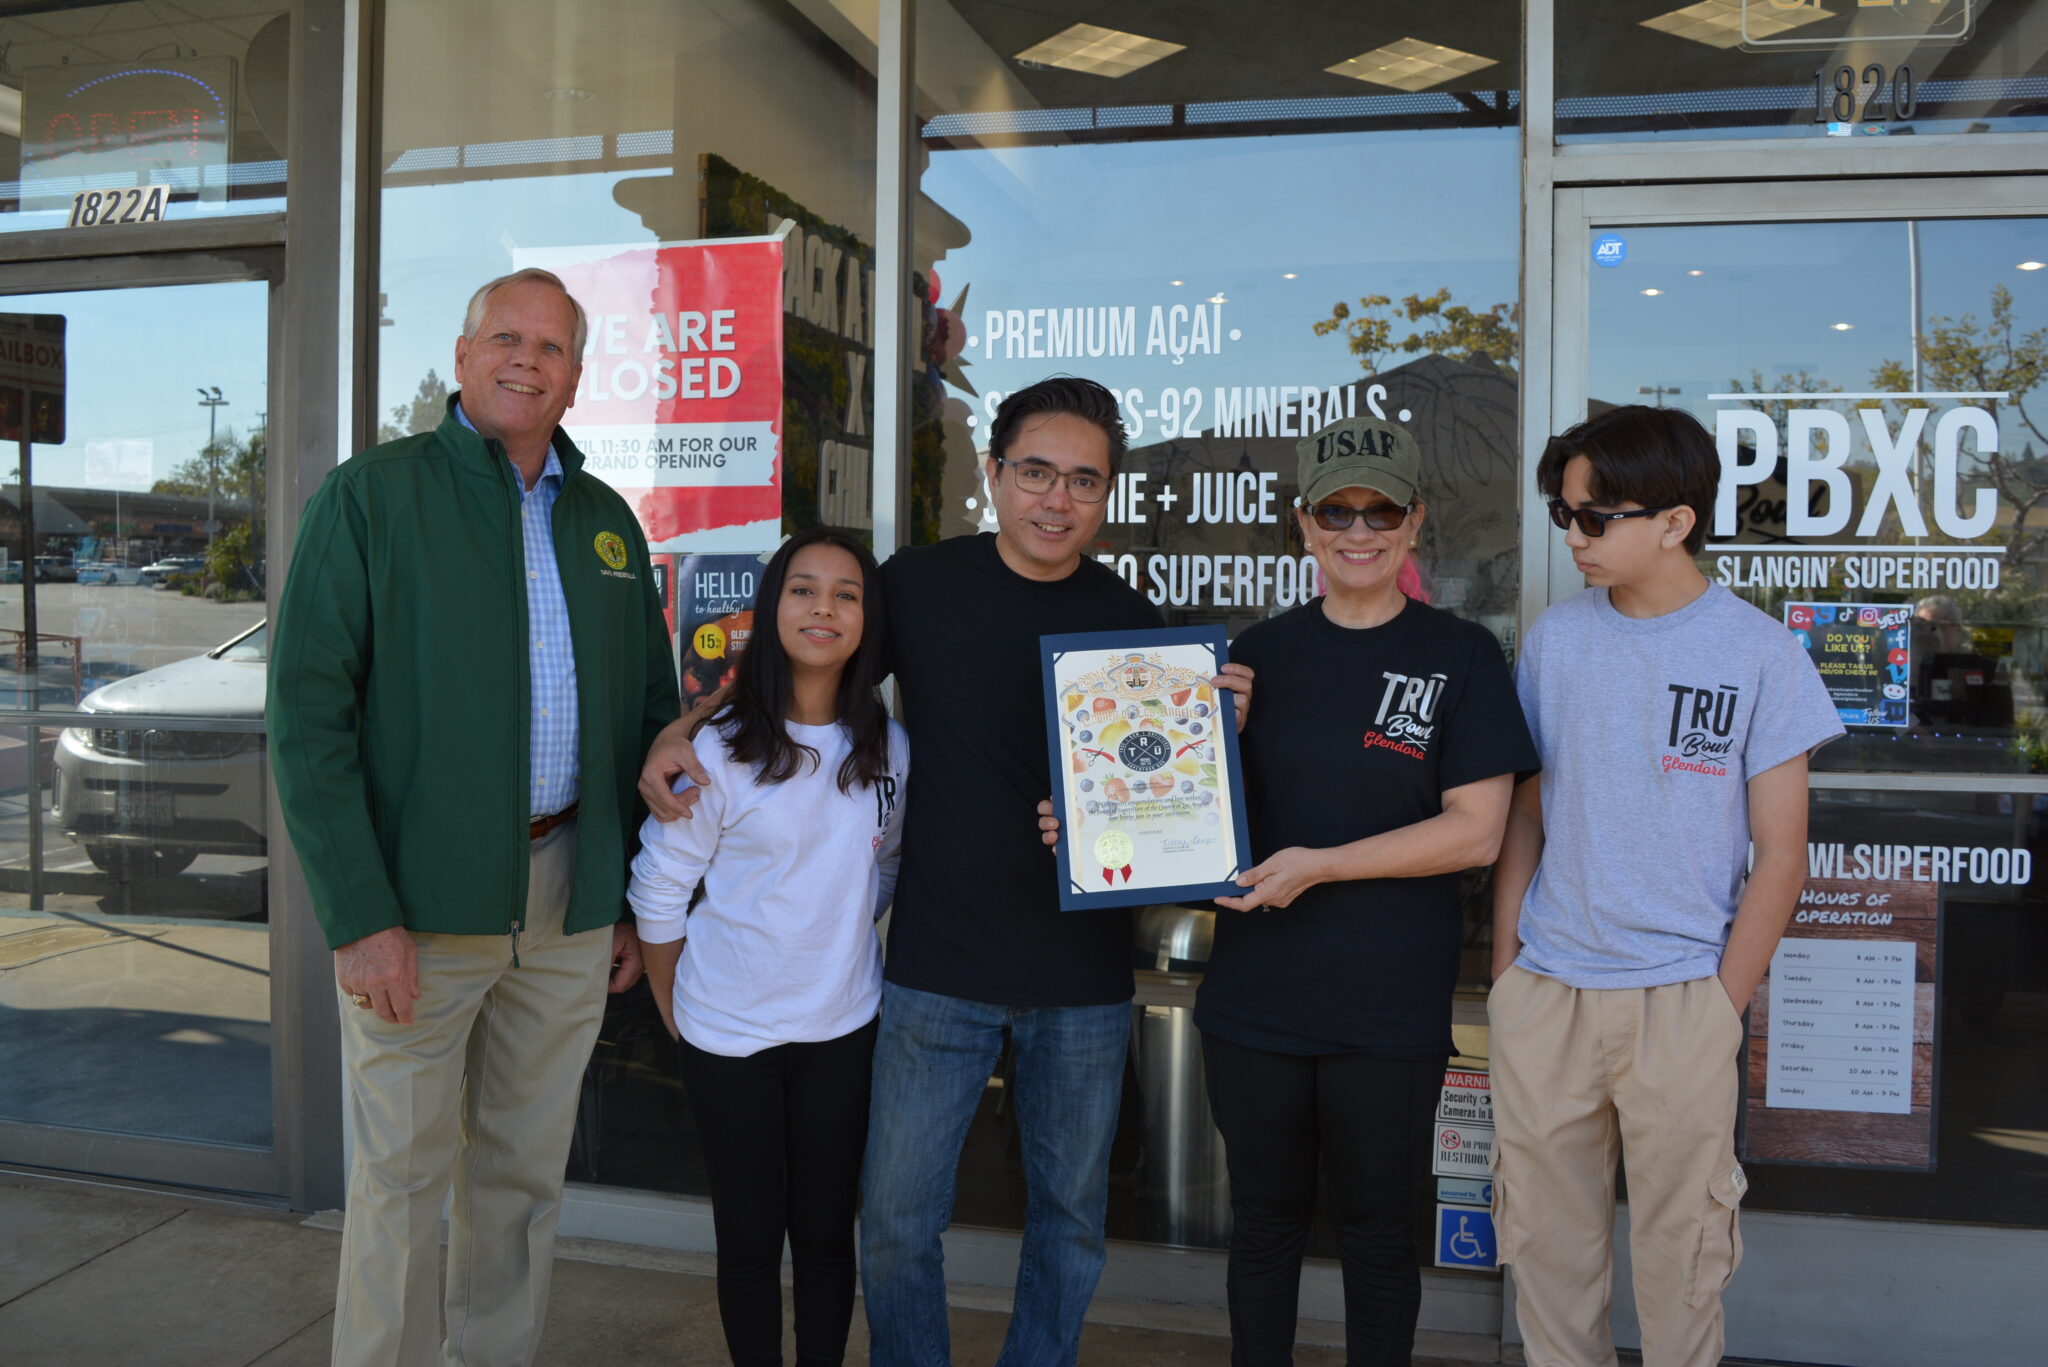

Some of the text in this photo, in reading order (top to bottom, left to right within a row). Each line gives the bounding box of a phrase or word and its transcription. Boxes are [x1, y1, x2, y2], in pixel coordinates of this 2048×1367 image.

[1813, 63, 1916, 124] 1820
[71, 187, 162, 227] 1822A
[1596, 242, 1623, 256] ADT
[642, 309, 736, 354] ARE
[985, 305, 1136, 360] PREMIUM
[574, 356, 743, 403] LOSED
[1214, 383, 1388, 438] MINERALS
[601, 439, 641, 454] 11:30
[646, 438, 673, 453] AM
[680, 437, 714, 452] FOR
[719, 436, 758, 452] OUR
[1316, 430, 1396, 464] USAF
[645, 453, 727, 469] OPENING
[1713, 406, 1999, 539] PBXC
[1186, 472, 1278, 524] JUICE
[695, 572, 754, 599] HELLO
[1146, 554, 1319, 608] SUPERFOO
[1843, 557, 2000, 590] SUPERFOOD
[695, 600, 745, 619] to healthy!
[1825, 644, 1871, 653] LIKE US?
[1826, 633, 1870, 643] DO YOU
[1385, 714, 1435, 740] Bowl
[1363, 731, 1425, 760] Glendora
[1681, 732, 1734, 757] Bowl
[1661, 755, 1727, 777] Glendora
[1748, 842, 2032, 885] WLSUPERFOOD
[1865, 892, 1892, 907] OF
[1795, 909, 1893, 926] OPERATION
[1444, 1073, 1491, 1089] WARNI
[1443, 1104, 1476, 1118] Cameras
[1444, 1090, 1478, 1106] Security
[1440, 1151, 1489, 1166] RESTROO
